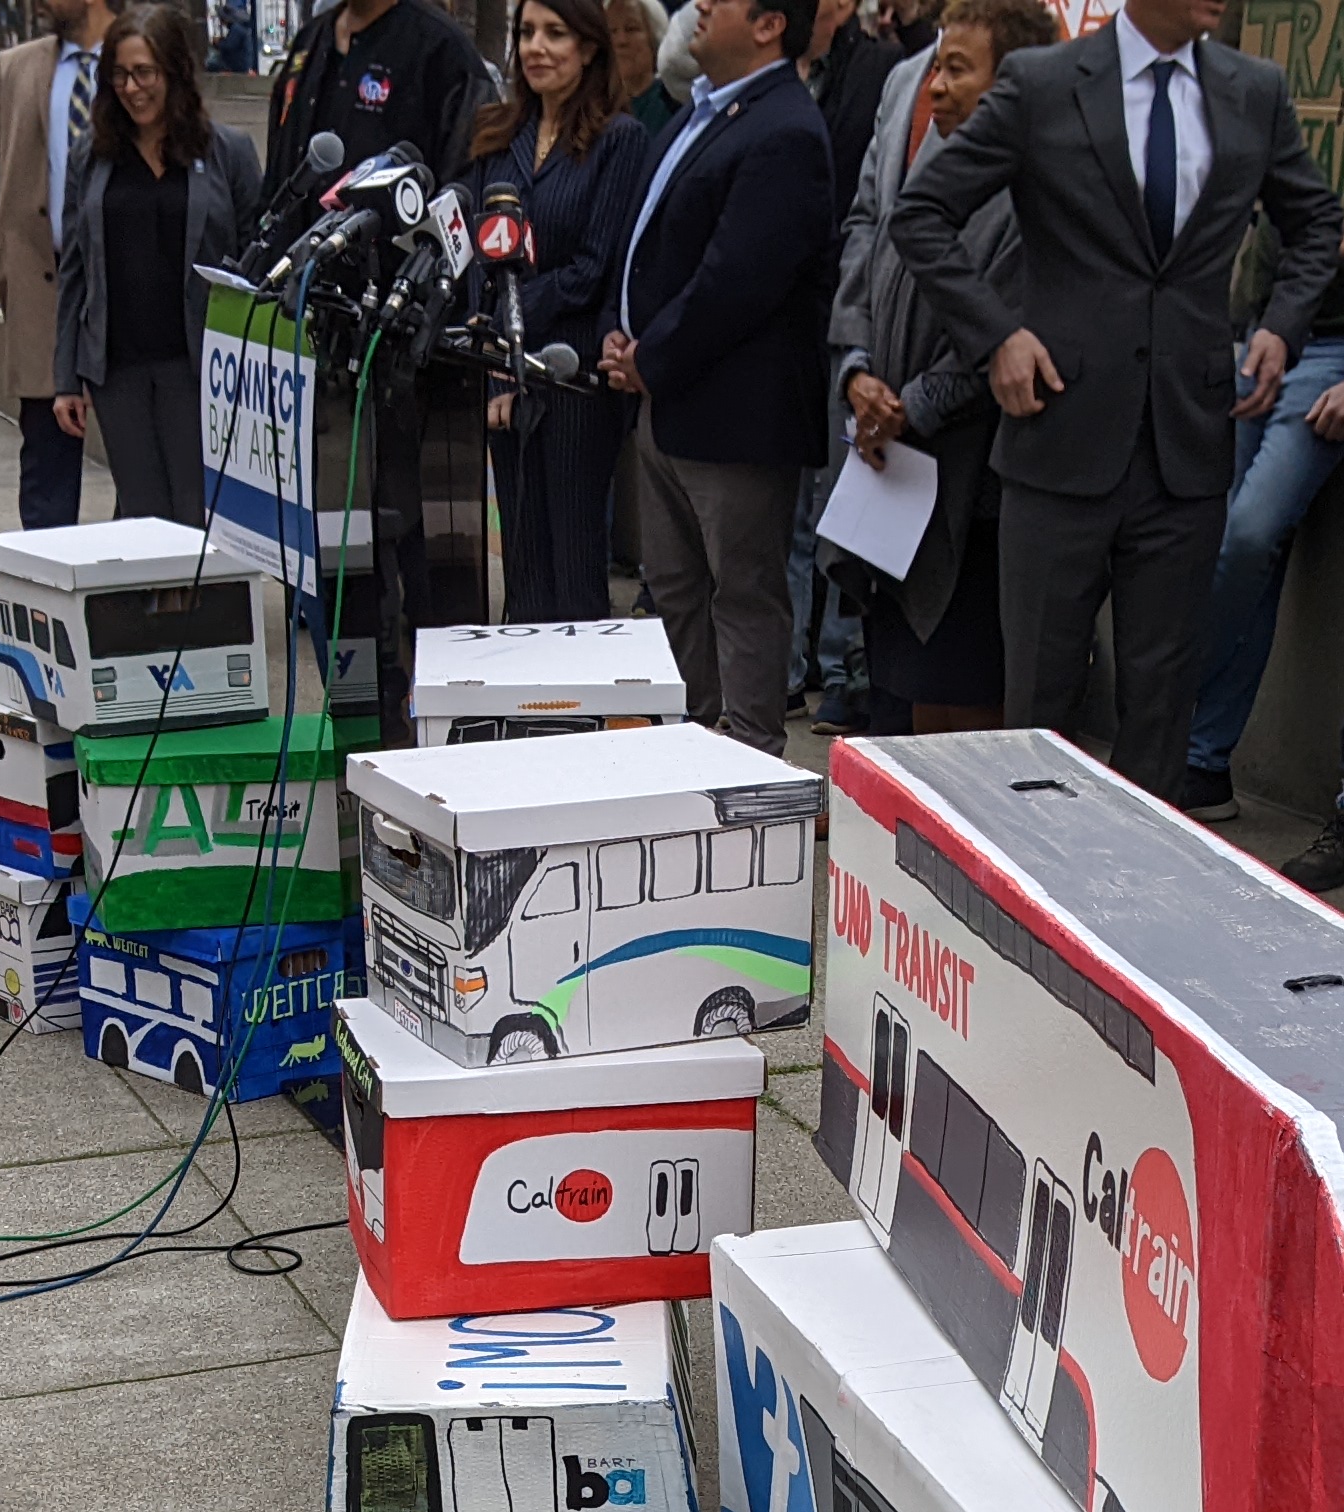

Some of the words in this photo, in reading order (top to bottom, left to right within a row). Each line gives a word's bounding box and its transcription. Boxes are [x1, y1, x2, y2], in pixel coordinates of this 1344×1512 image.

[482, 216, 512, 254] 4
[209, 347, 306, 428] CONNECT
[209, 403, 242, 464] BAY
[448, 623, 632, 642] 3042
[246, 799, 300, 820] Transit
[879, 897, 975, 1041] TRANSIT
[357, 1060, 373, 1101] City
[507, 1175, 607, 1214] Caltrain
[1082, 1131, 1195, 1325] Caltrain
[587, 1457, 636, 1469] BART
